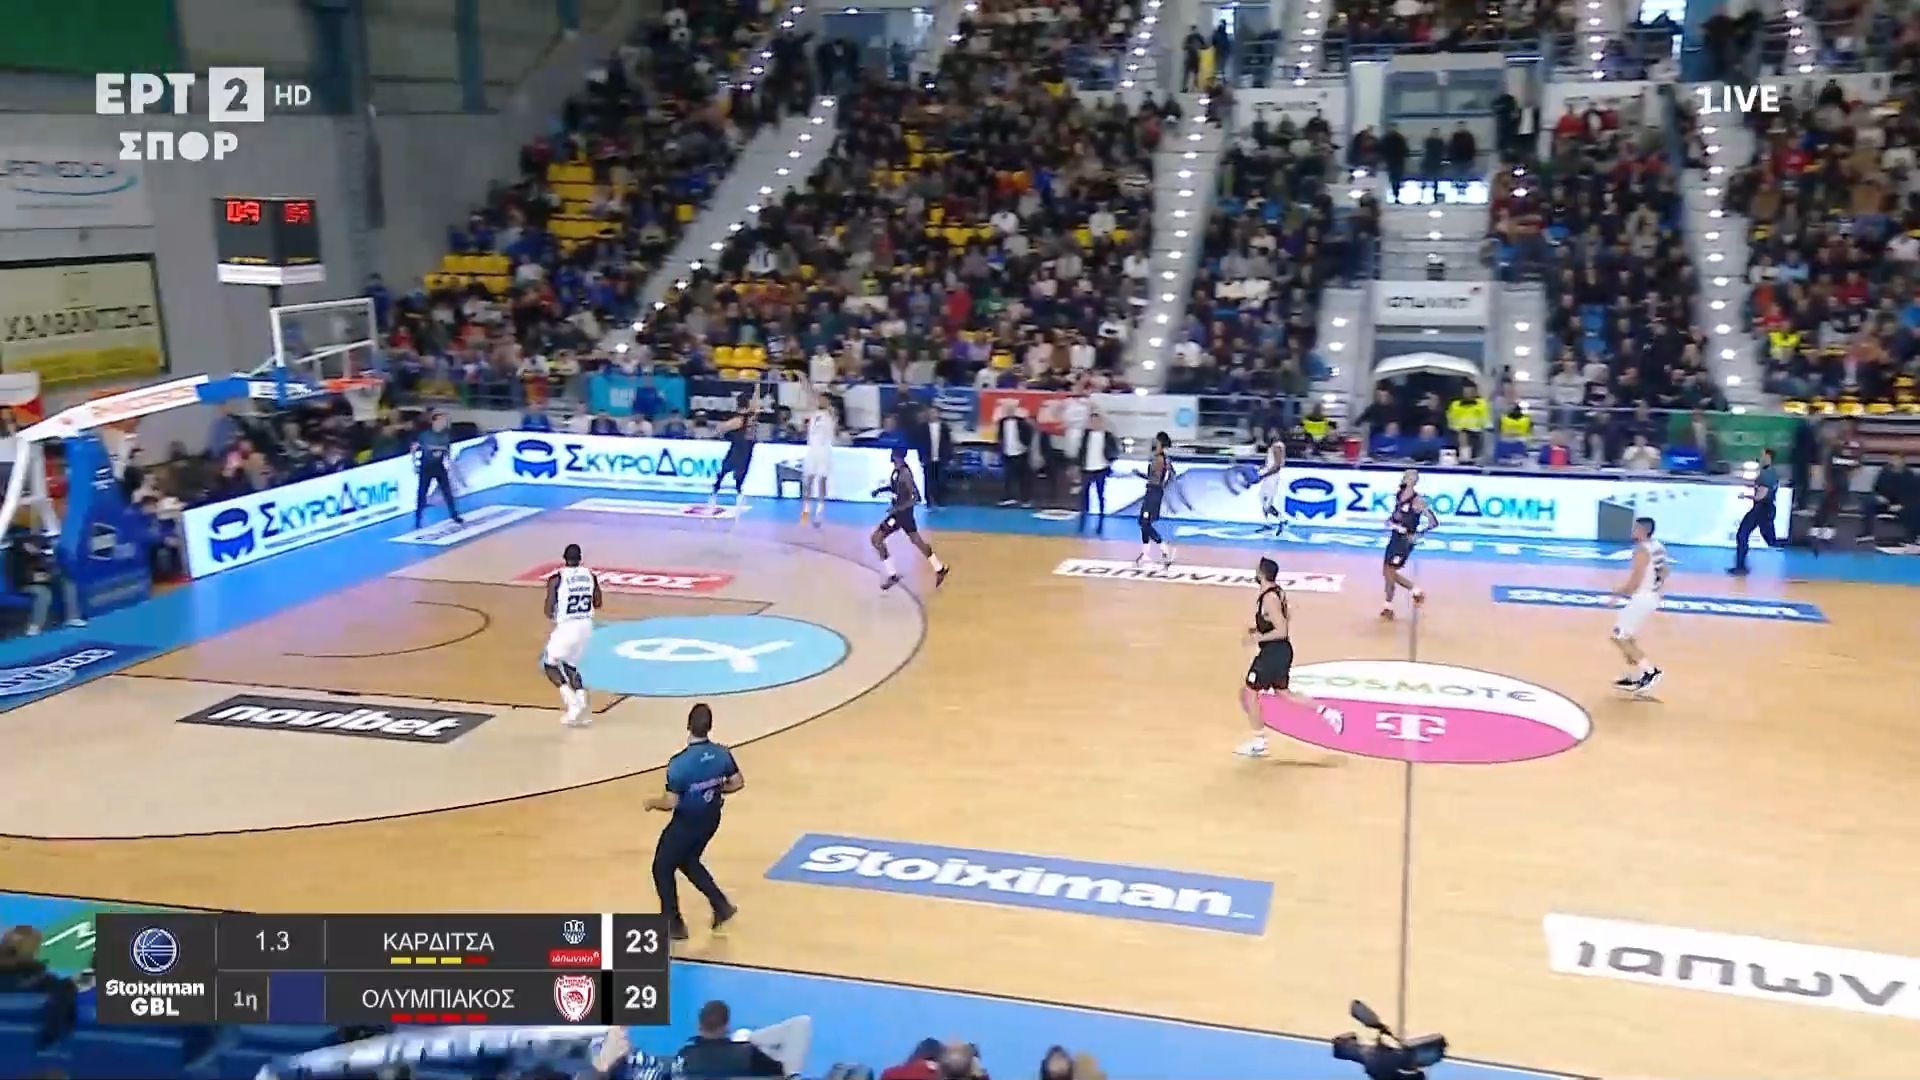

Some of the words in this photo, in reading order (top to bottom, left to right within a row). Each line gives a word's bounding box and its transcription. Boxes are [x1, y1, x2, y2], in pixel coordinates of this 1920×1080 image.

[565, 444, 721, 479] ΣΚΥΡΟΔΟΜ
[1346, 482, 1556, 521] ΣΚΟΔΟΜΗ
[566, 594, 593, 614] 23
[1292, 673, 1537, 703] COSMOTE
[208, 702, 461, 738] novibet
[799, 843, 1238, 917] Stoiximan
